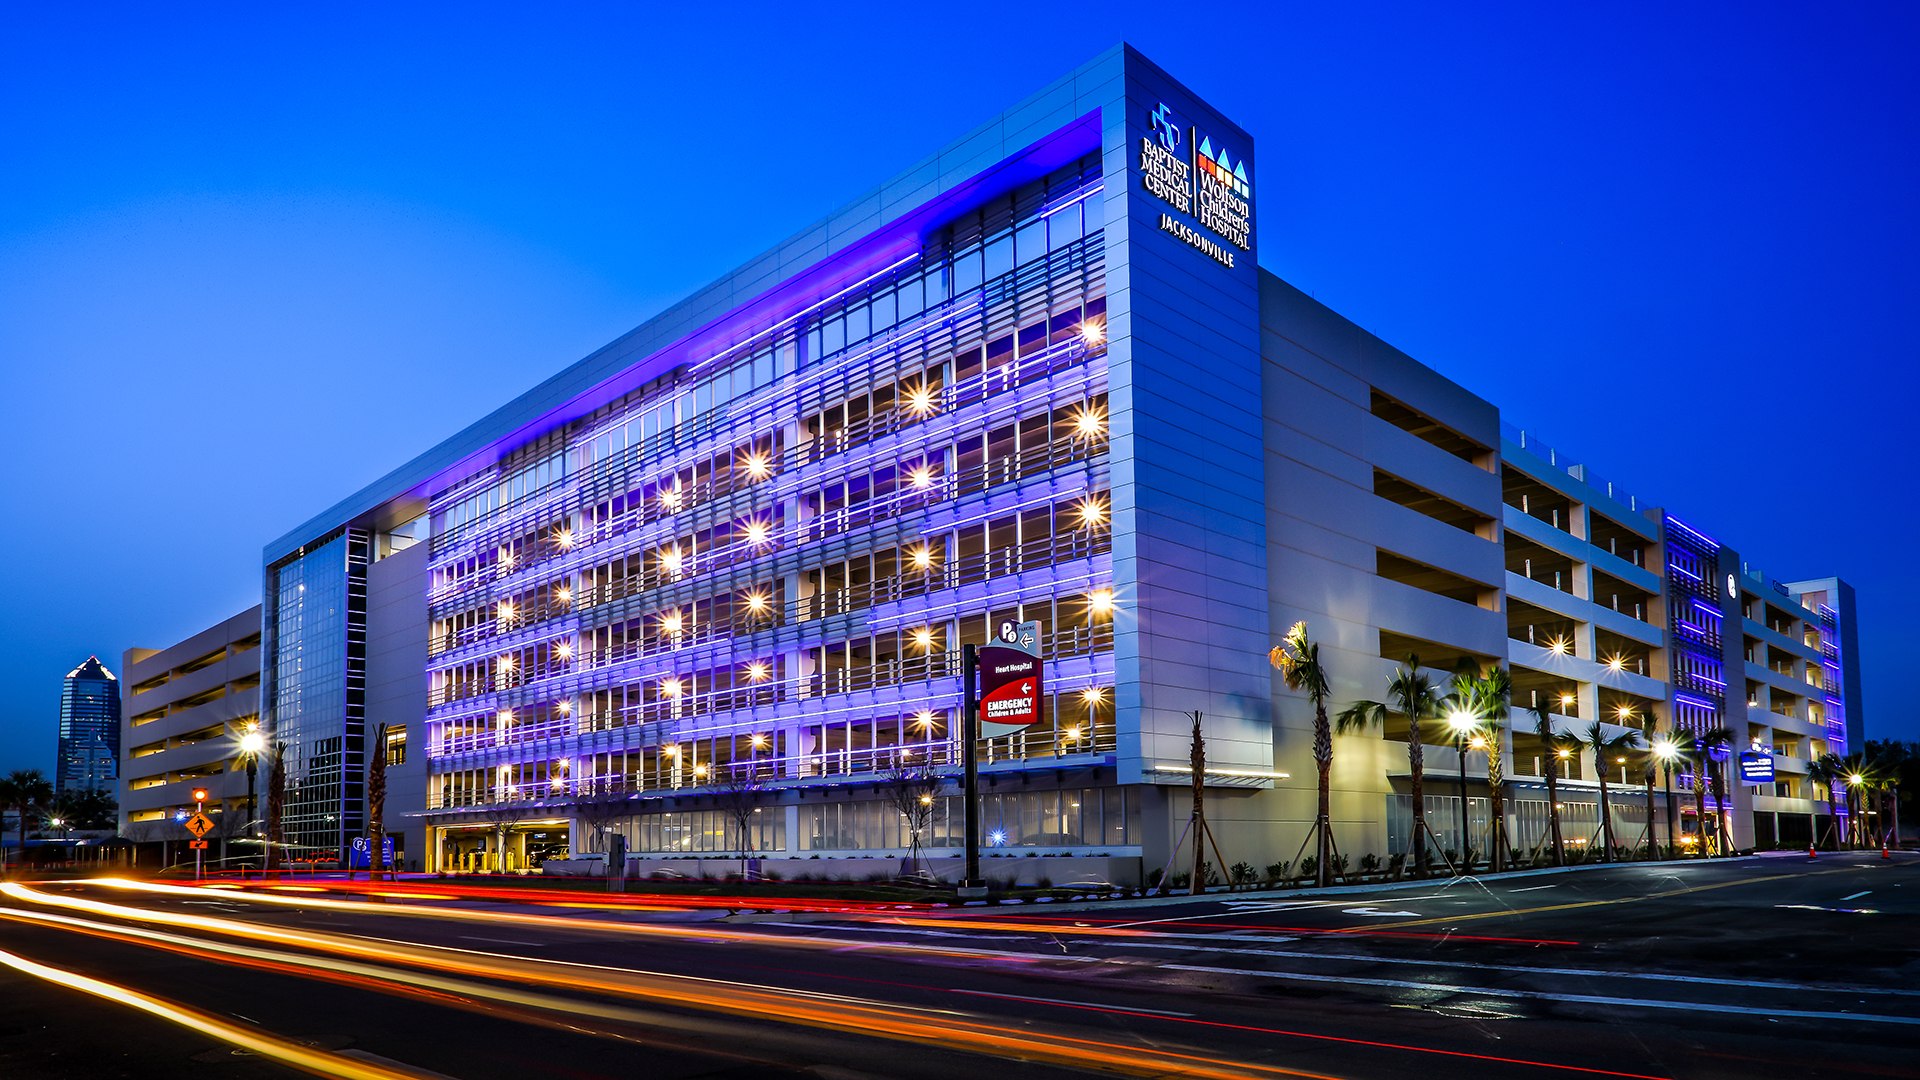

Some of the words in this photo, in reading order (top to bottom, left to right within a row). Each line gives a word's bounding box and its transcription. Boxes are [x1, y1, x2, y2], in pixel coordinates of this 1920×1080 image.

[1141, 153, 1192, 198] MEDICAL
[1143, 137, 1190, 179] BAPTIST
[1145, 173, 1190, 213] CENTER
[1199, 167, 1250, 218] Wolfson
[1160, 213, 1234, 268] JACKSONVILLE
[1200, 204, 1250, 250] HOSPITAL
[1002, 622, 1012, 639] P
[995, 665, 1010, 674] Heart
[1010, 662, 1032, 672] Hospital
[987, 697, 1032, 711] EMERGENCY
[987, 710, 1009, 718] Children
[1009, 708, 1014, 716] &
[1014, 707, 1032, 715] Adults
